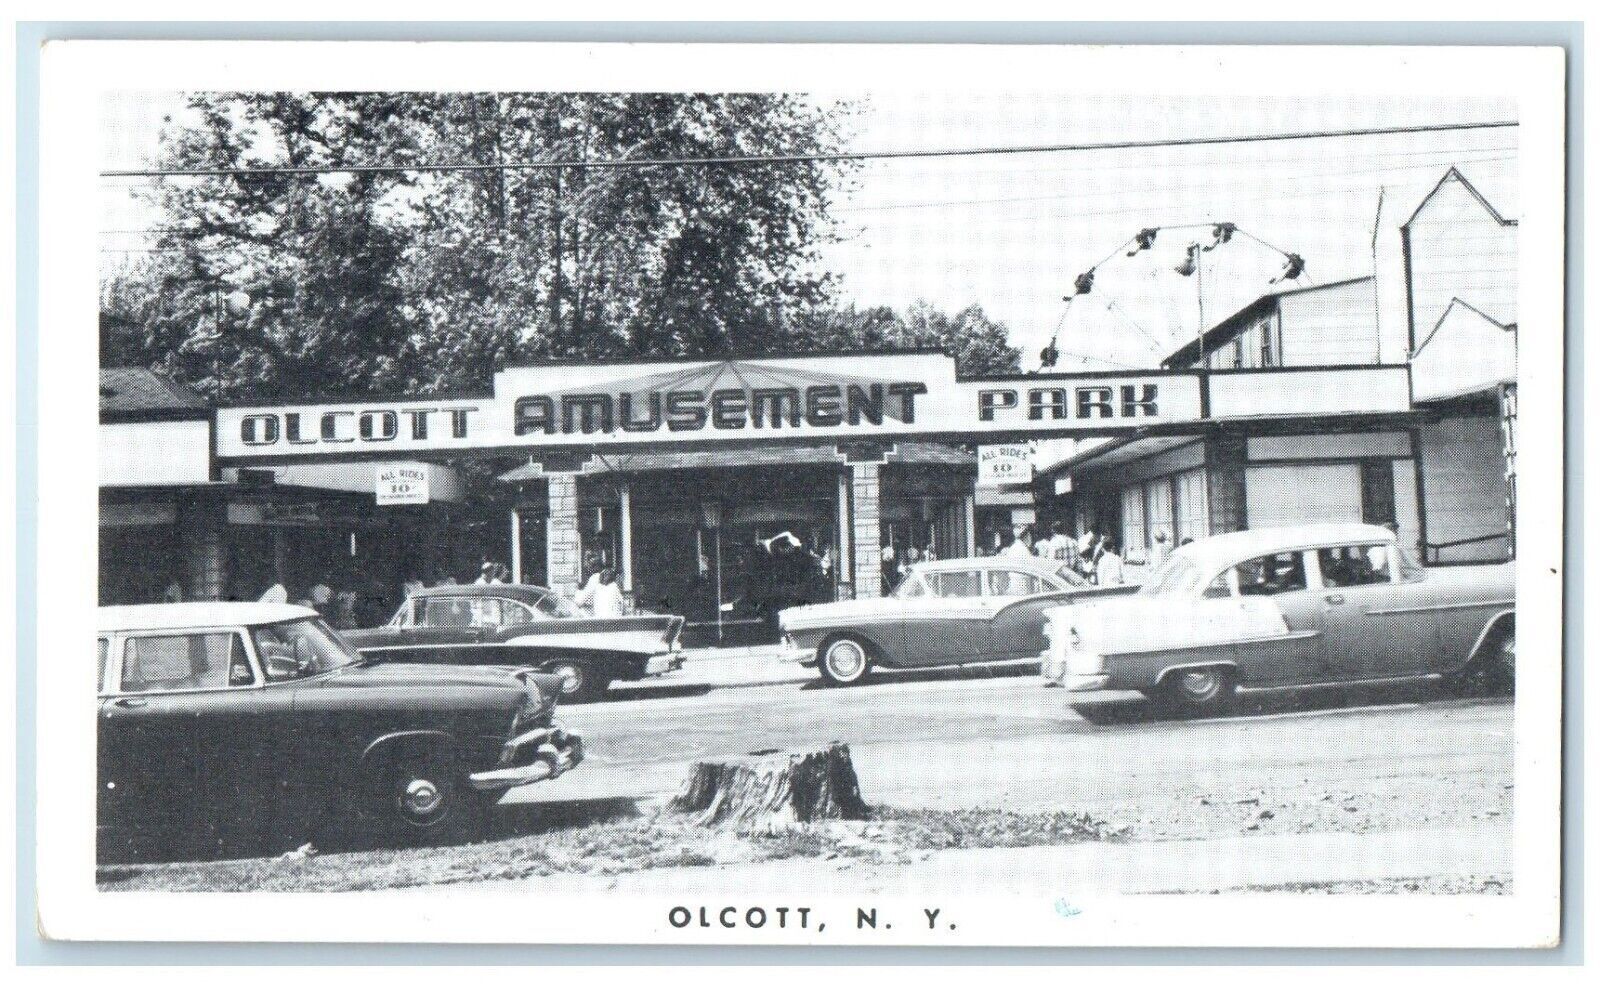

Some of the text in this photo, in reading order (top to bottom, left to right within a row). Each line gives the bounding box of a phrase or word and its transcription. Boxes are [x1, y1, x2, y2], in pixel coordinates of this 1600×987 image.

[241, 382, 1158, 446] OLCOTT AMUSEMENT PARK
[982, 447, 1027, 461] ALL RIDES
[381, 469, 424, 481] ALL RIDES
